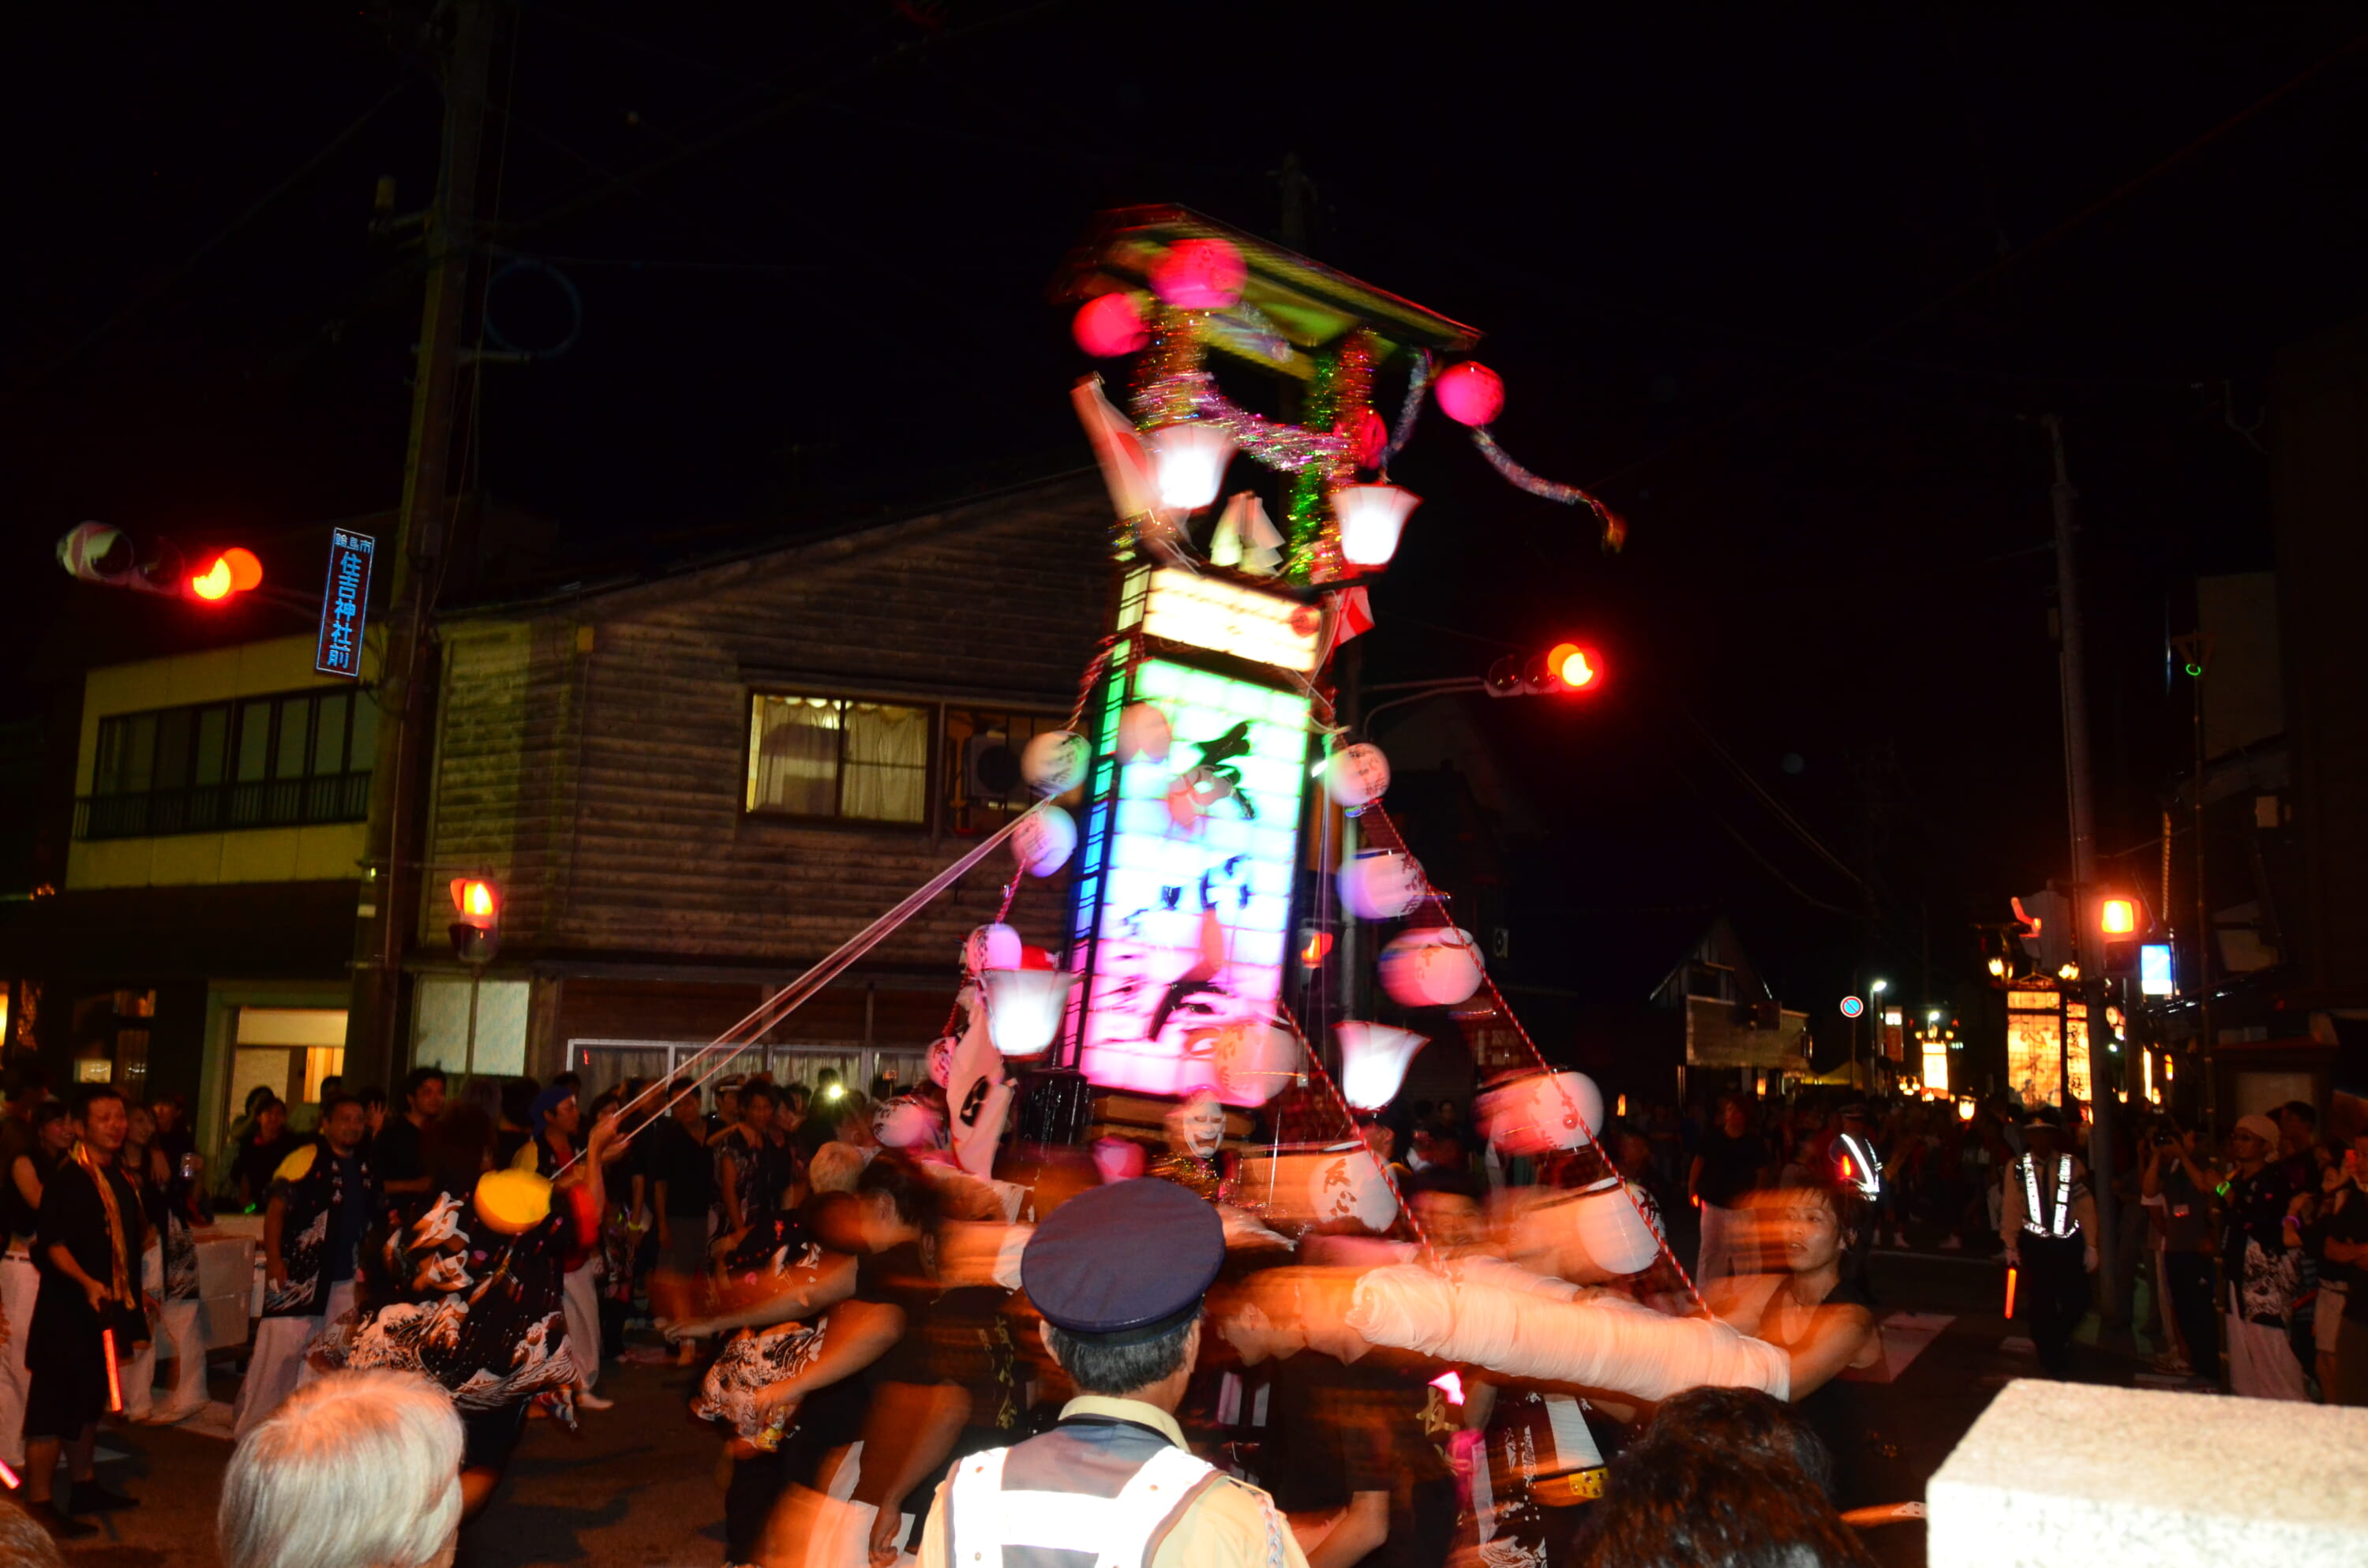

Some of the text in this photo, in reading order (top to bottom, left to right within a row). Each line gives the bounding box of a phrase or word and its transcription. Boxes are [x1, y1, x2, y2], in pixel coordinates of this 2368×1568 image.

[327, 552, 362, 669] 住吉神社前
